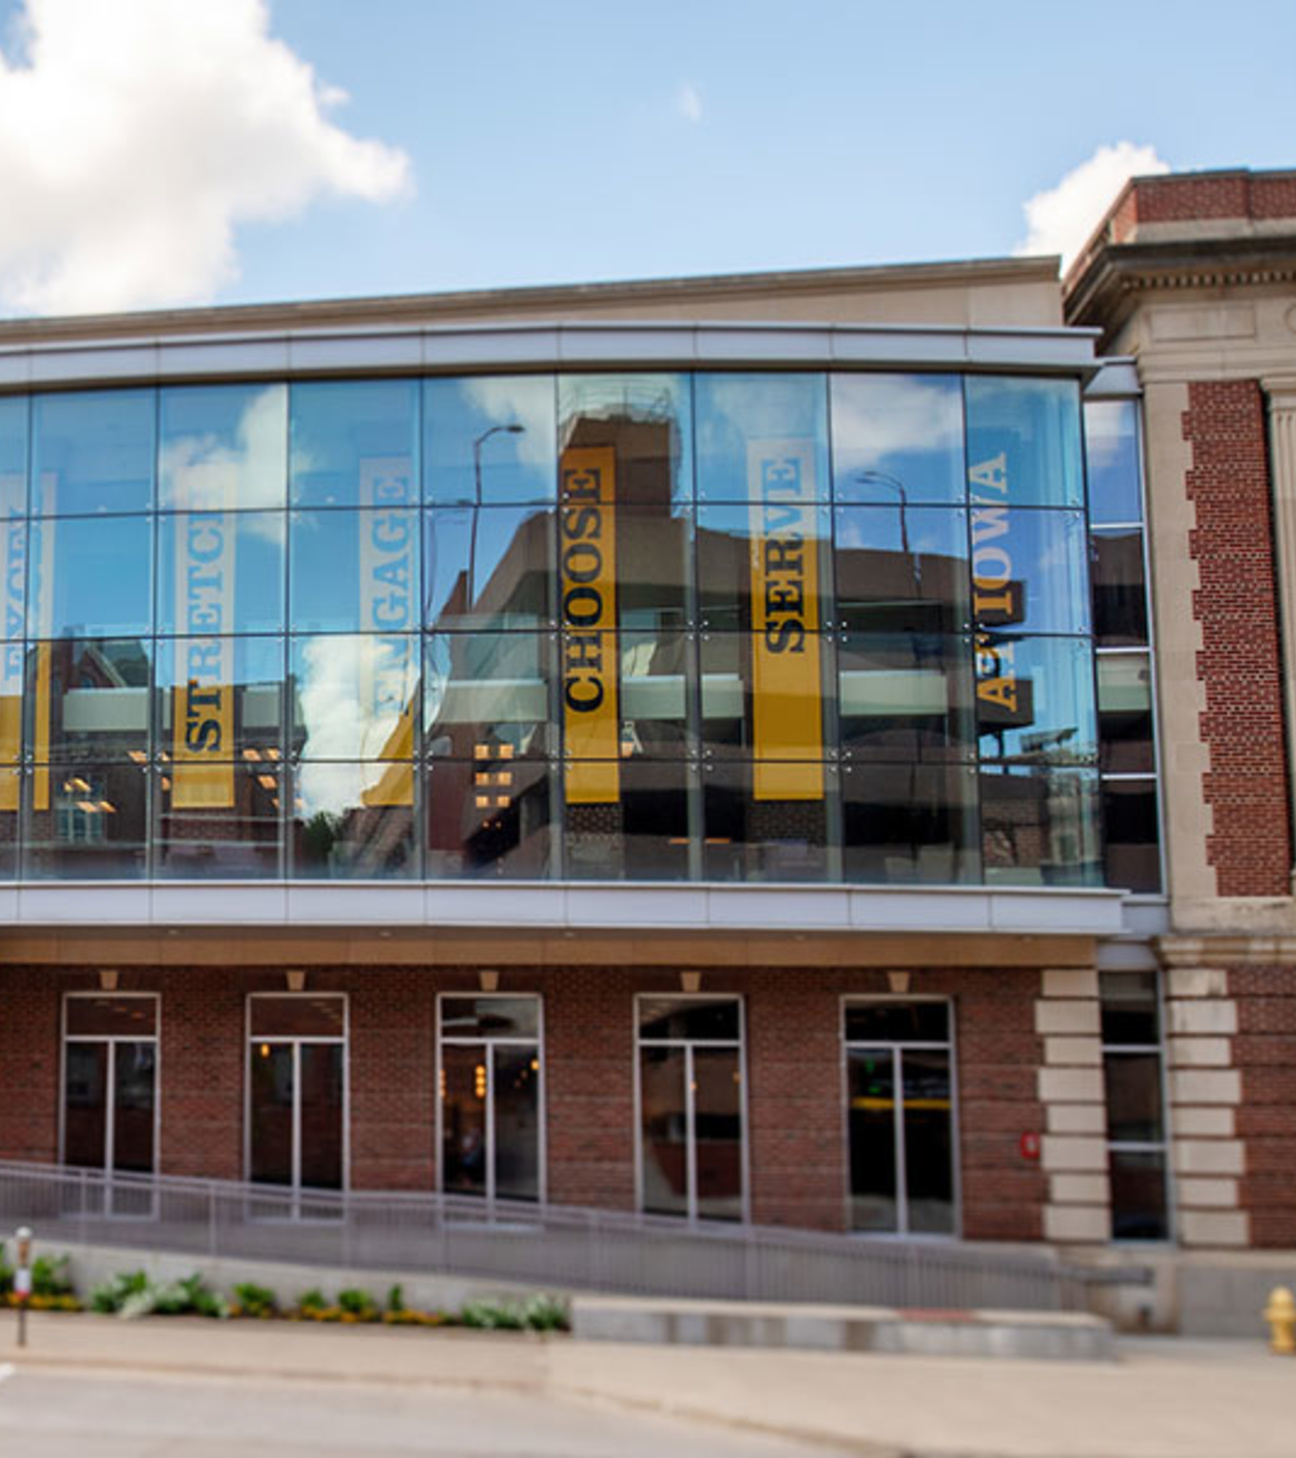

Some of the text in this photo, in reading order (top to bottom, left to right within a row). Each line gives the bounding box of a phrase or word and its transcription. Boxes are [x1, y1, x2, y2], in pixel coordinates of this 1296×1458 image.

[185, 485, 224, 753] STRETCH
[371, 475, 412, 719] ENGAGE
[563, 467, 604, 713] CHOOSE
[763, 457, 804, 654] SERVE
[970, 452, 1013, 616] IOWA
